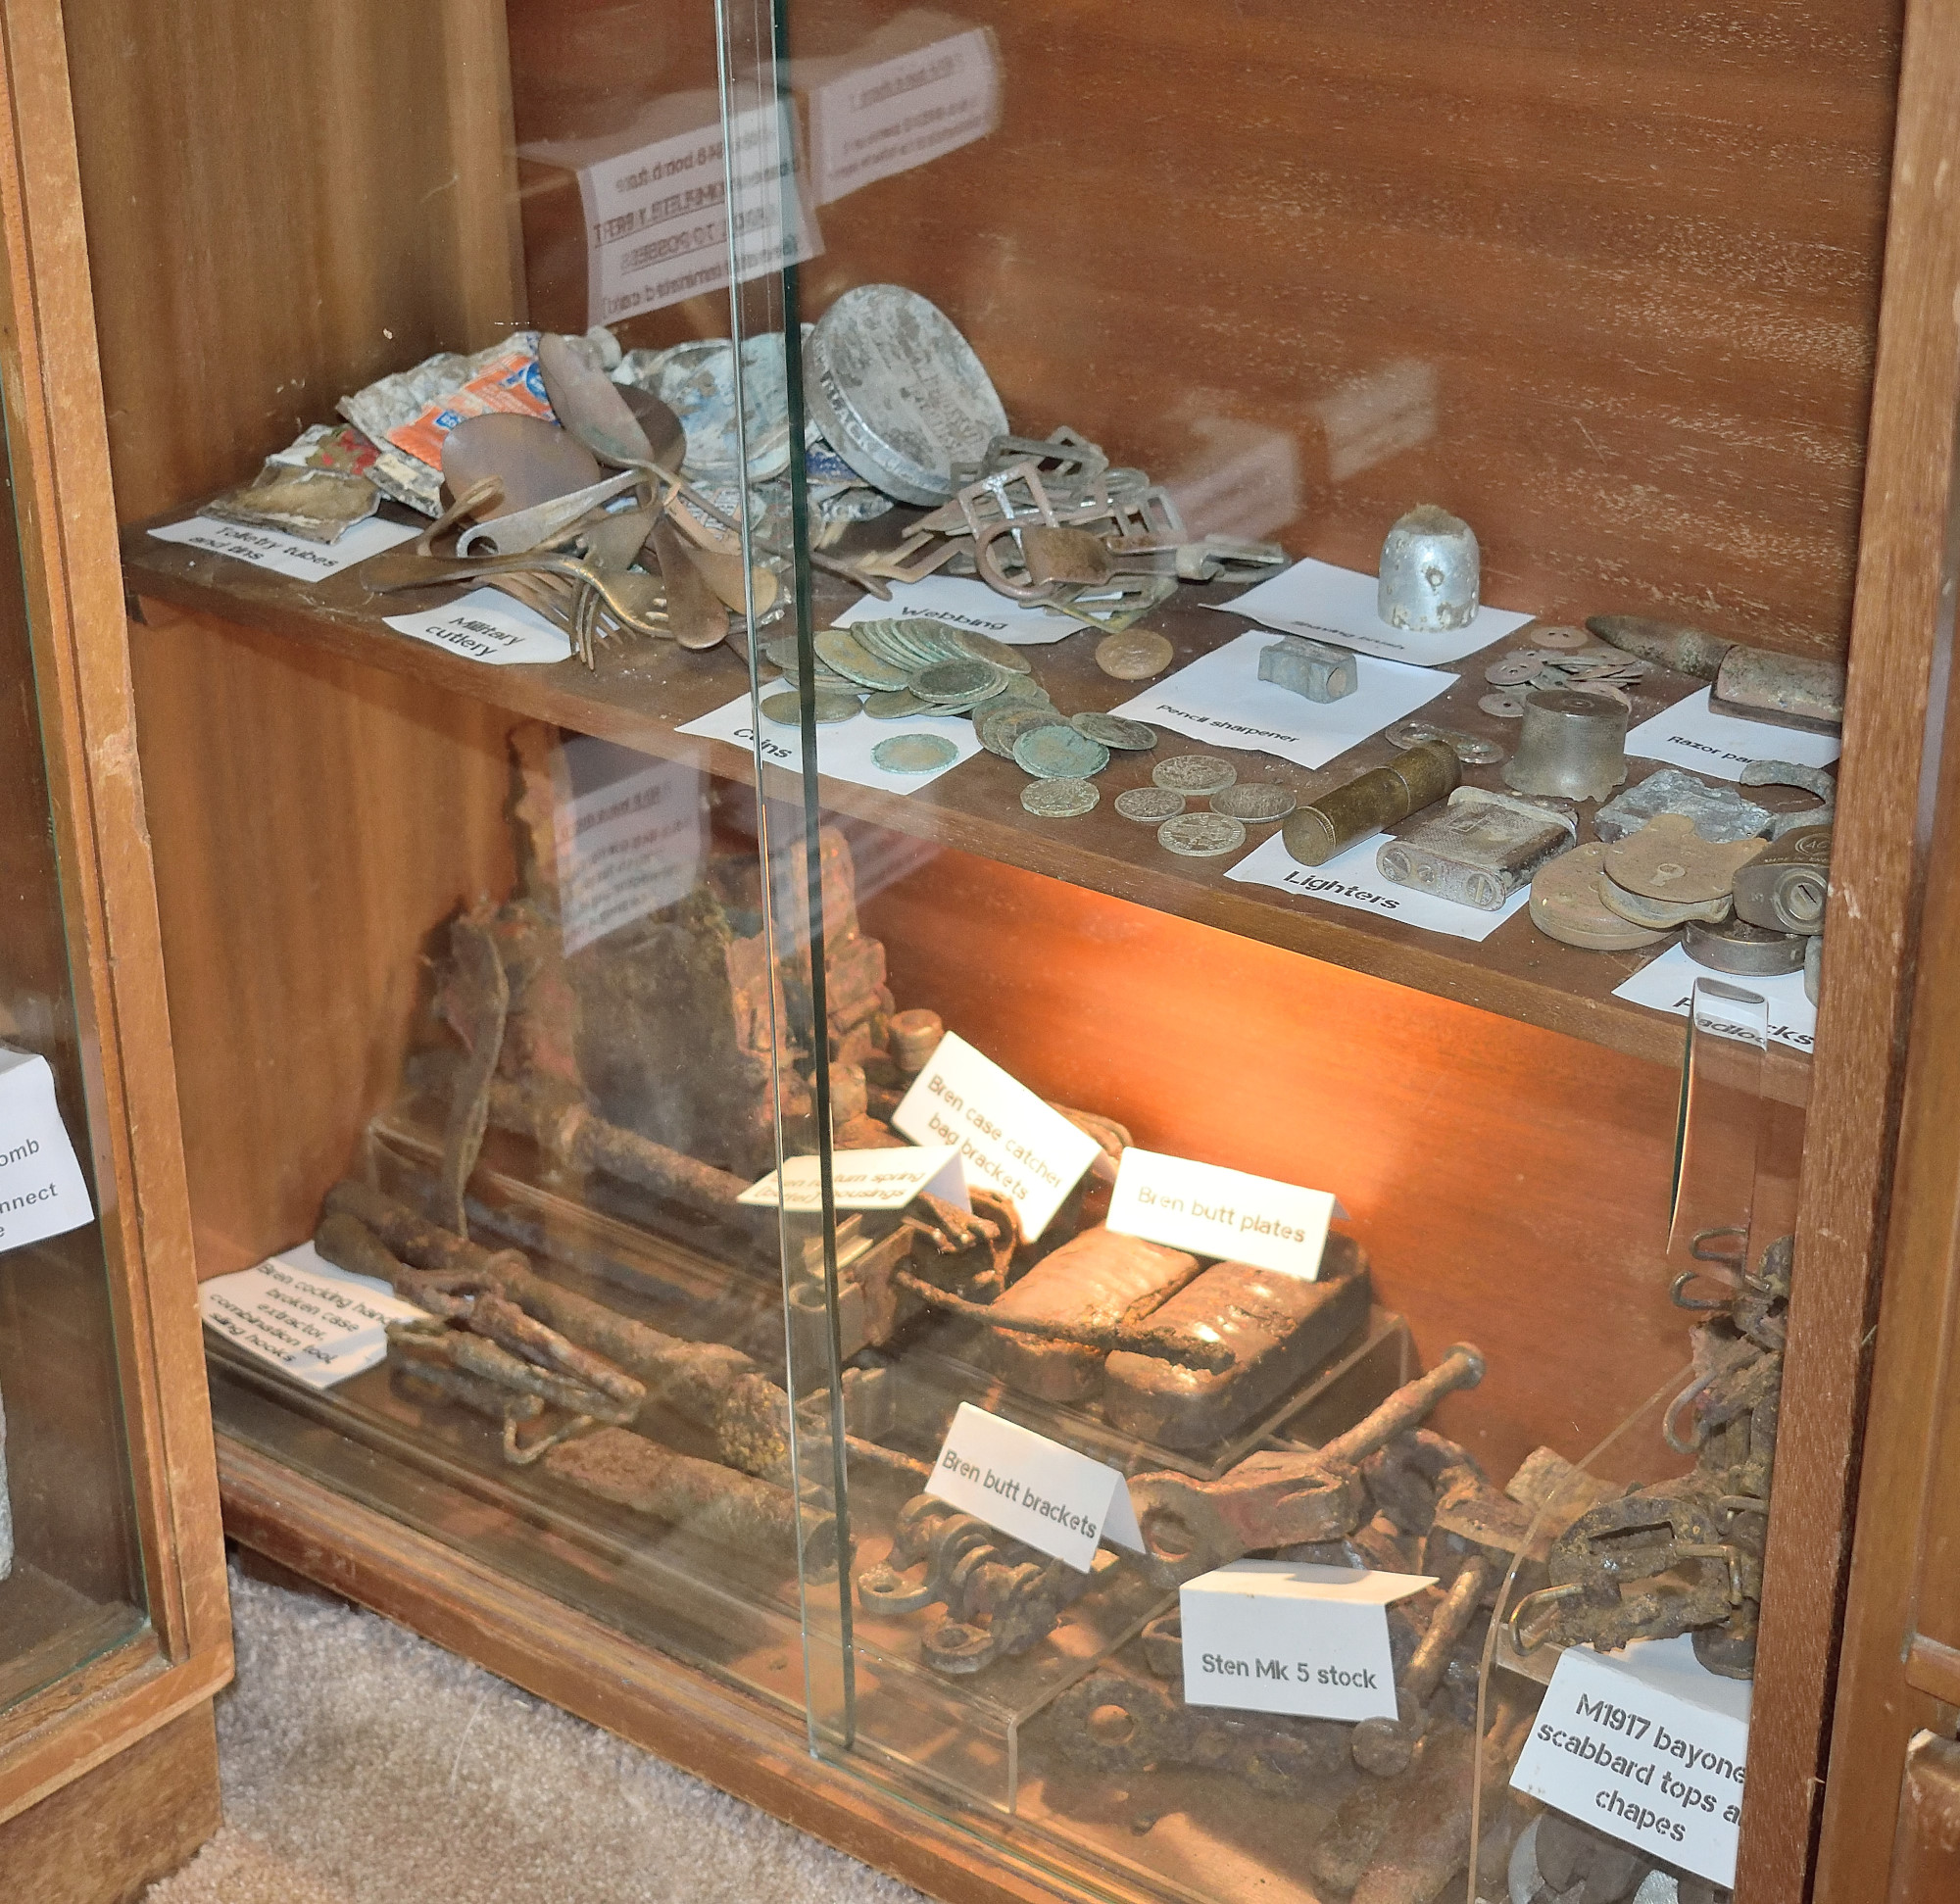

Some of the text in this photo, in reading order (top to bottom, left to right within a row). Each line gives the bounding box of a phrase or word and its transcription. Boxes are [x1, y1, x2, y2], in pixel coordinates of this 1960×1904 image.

[227, 545, 265, 561] tins
[282, 546, 339, 568] tubes
[425, 625, 498, 657] cutlery
[449, 616, 525, 646] Military
[902, 607, 1008, 630] Webbing
[1156, 704, 1299, 743] Pencil sharpener
[1666, 735, 1722, 755] Razor
[1283, 870, 1400, 909] Lighters
[927, 1073, 1063, 1189] Bren case catcher
[870, 1170, 926, 1184] spring
[928, 1111, 1029, 1200] bag brackets
[1137, 1186, 1306, 1244] Bren butt plates
[257, 1263, 293, 1285] Bren
[294, 1281, 354, 1309] cocking
[210, 1293, 302, 1347] combination
[266, 1288, 361, 1333] broken case
[209, 1311, 297, 1362] sling hooks
[942, 1449, 1098, 1539] Bren butt brackets
[1201, 1652, 1378, 1689] Sten Mk 5 stock
[1575, 1692, 1652, 1740] M1917
[1537, 1723, 1656, 1786] scabbard
[1659, 1771, 1718, 1814] tops
[1594, 1789, 1687, 1842] chapes
